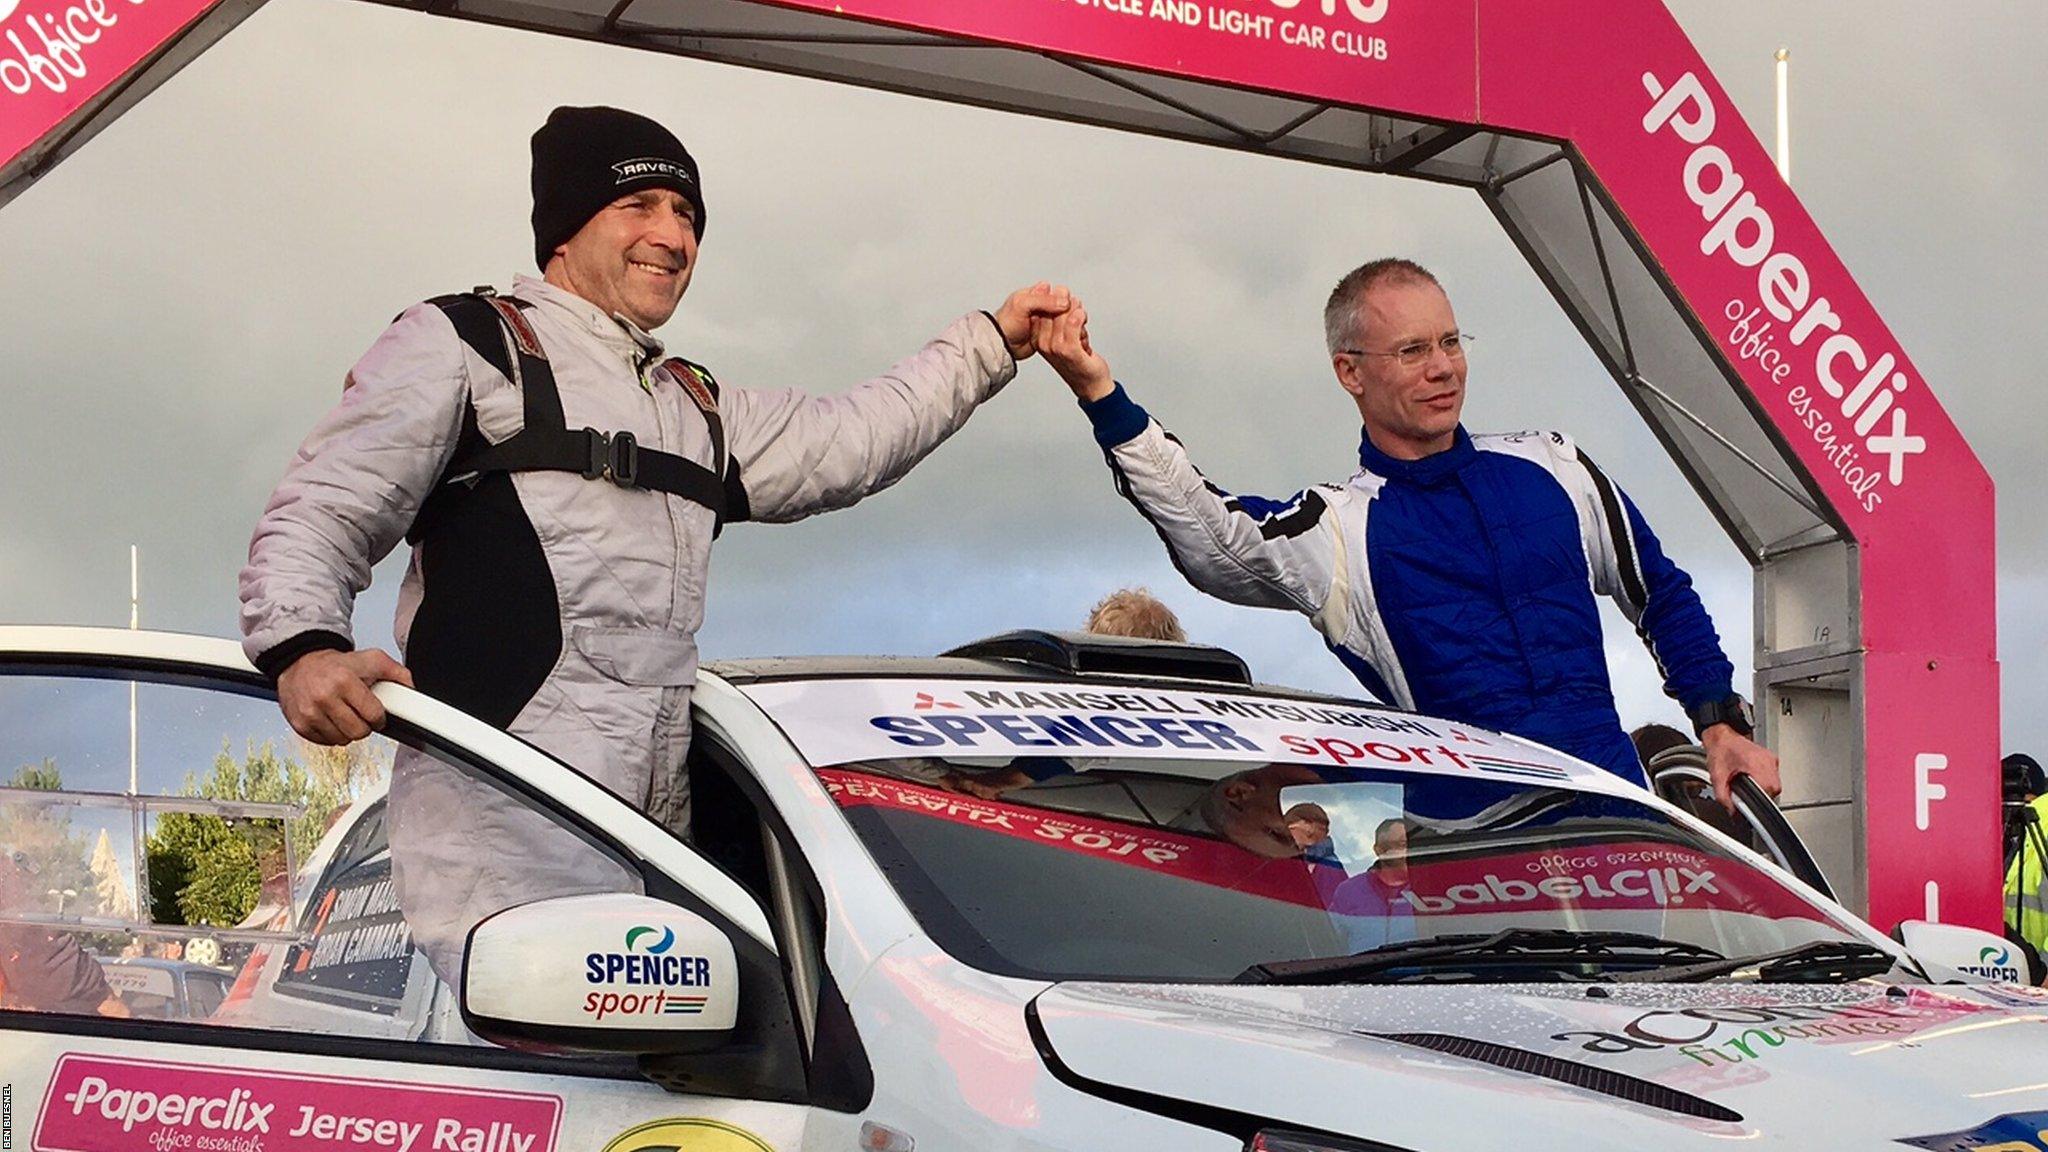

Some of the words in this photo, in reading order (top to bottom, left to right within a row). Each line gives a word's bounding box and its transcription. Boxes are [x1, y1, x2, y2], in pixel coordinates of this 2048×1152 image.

[1150, 0, 1201, 26] AND
[1208, 7, 1274, 39] LIGHT
[1280, 21, 1326, 50] CAR
[1331, 30, 1388, 61] CLUB
[1724, 299, 1792, 385] office
[1787, 385, 1884, 513] essentials
[963, 690, 1200, 714] MANSELL
[1193, 698, 1442, 739] MITSUBISHI
[869, 714, 1265, 752] SPENCER
[1279, 734, 1471, 769] sport
[585, 953, 711, 987] SPENCER
[583, 989, 666, 1021] sport
[64, 1076, 276, 1135] Paperclix
[289, 1104, 422, 1152] Jersey
[432, 1117, 536, 1152] Rally
[148, 1126, 194, 1152] office
[196, 1134, 265, 1152] essentials
